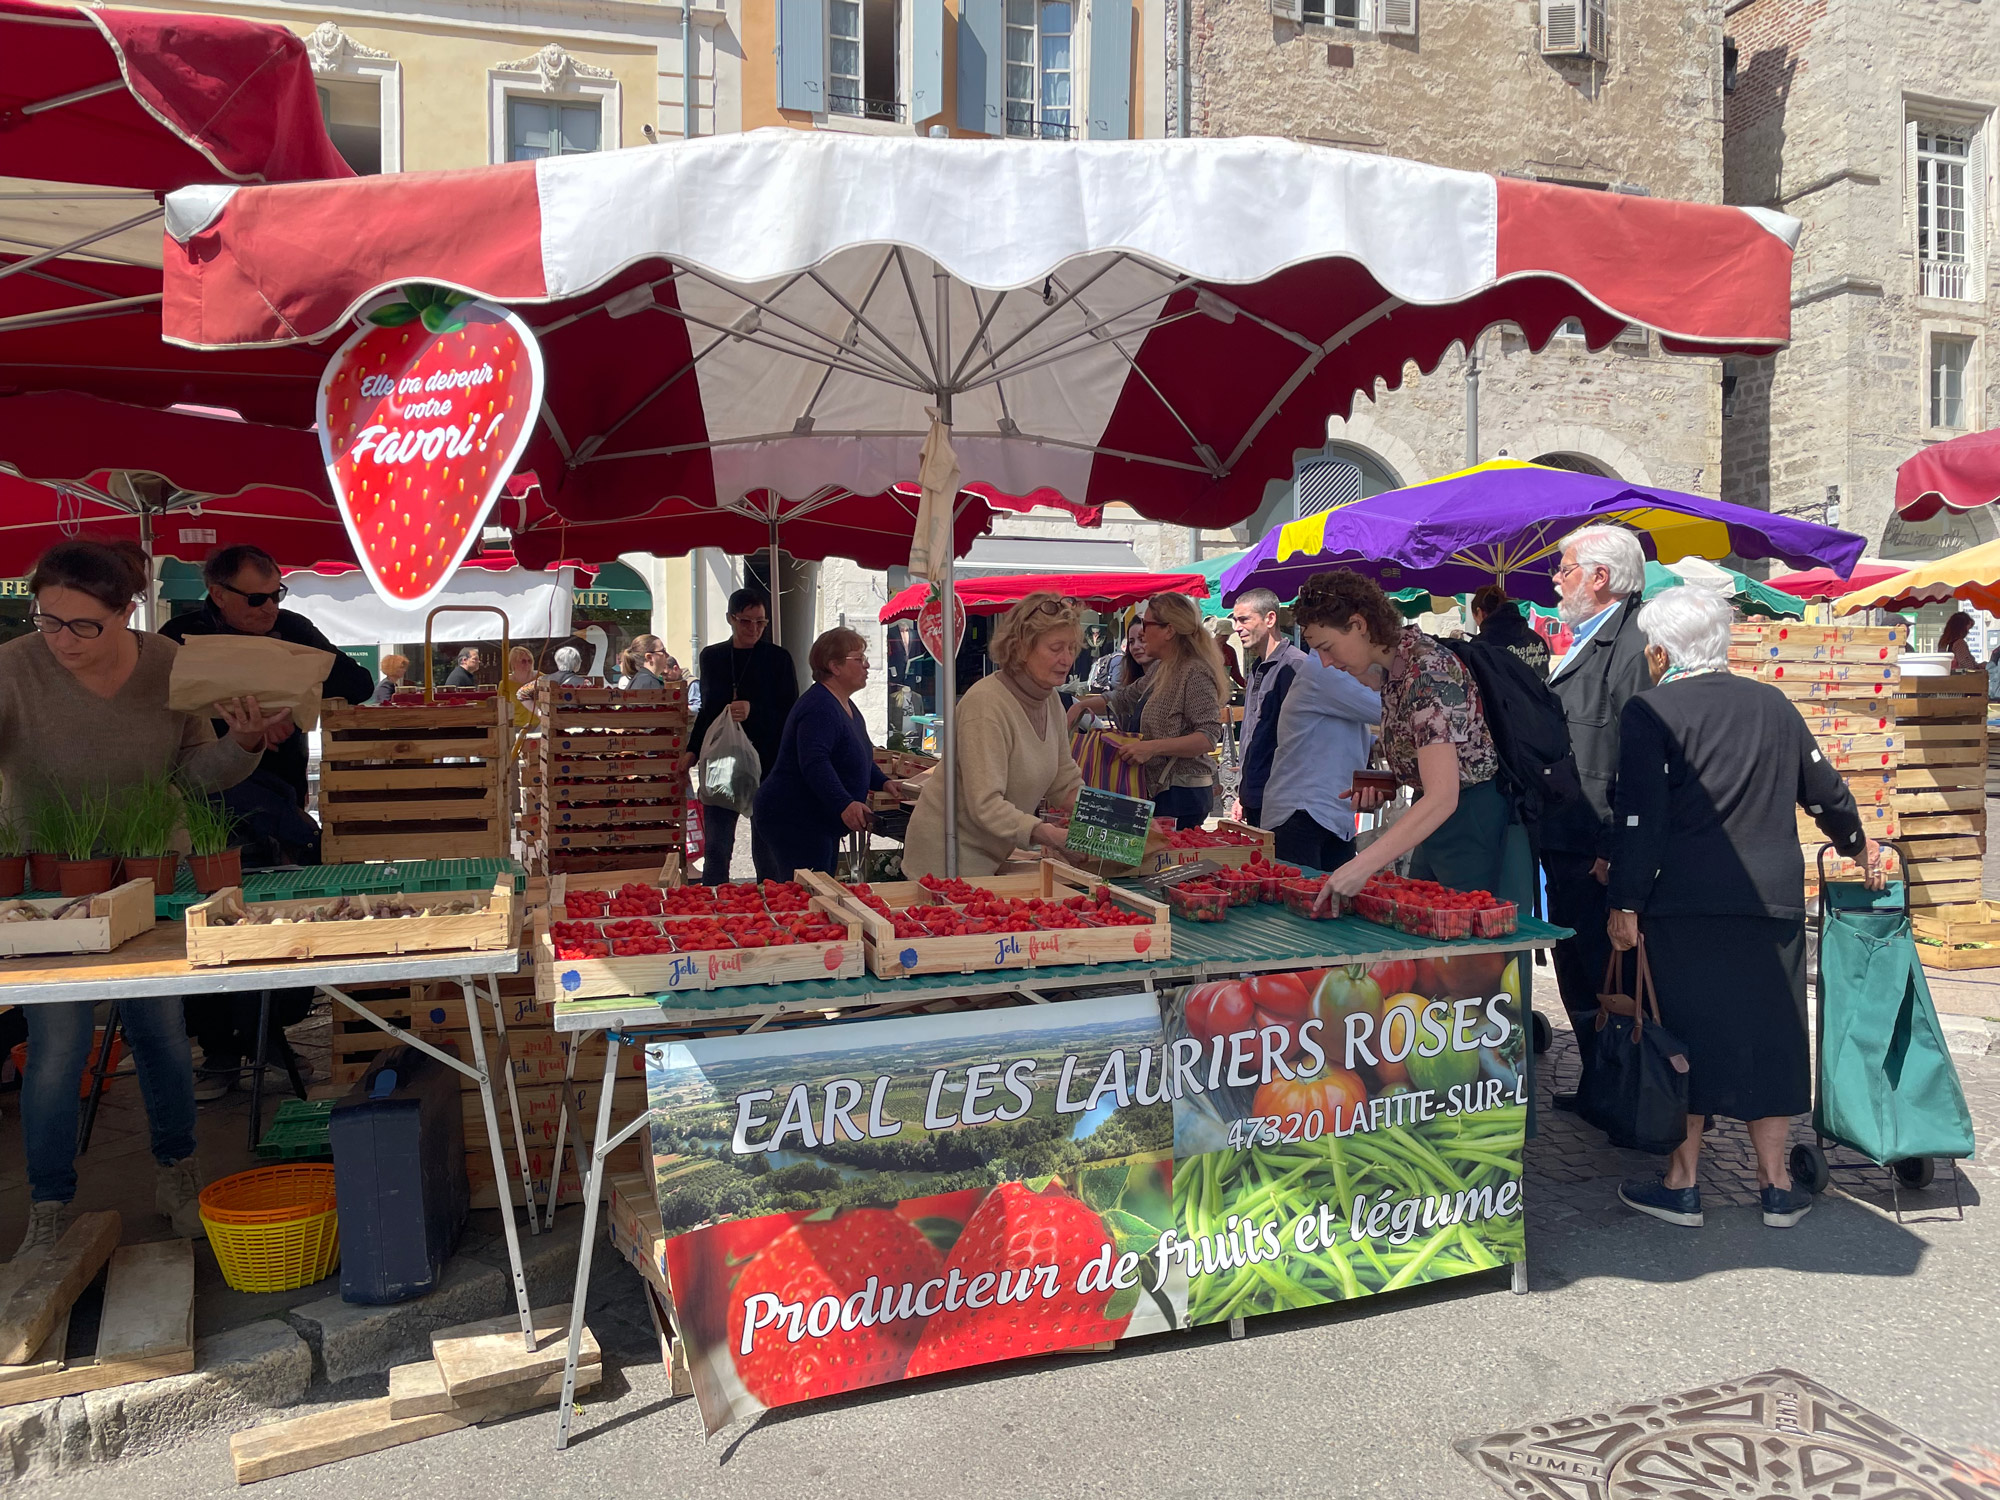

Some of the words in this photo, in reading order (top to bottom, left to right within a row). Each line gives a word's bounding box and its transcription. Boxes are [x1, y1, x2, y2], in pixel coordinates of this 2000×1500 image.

[360, 374, 395, 397] Elle
[398, 377, 422, 394] va
[425, 363, 494, 392] devenir
[404, 398, 453, 420] votre
[1155, 852, 1172, 872] Joli
[994, 936, 1022, 965] Joli
[1029, 934, 1061, 960] fruit
[669, 956, 699, 986] Joli
[708, 953, 744, 981] fruit
[514, 998, 538, 1021] Joli
[731, 1075, 902, 1155] EARL
[924, 1058, 1038, 1131] LES
[1055, 1017, 1326, 1114] LAURIERS
[1343, 992, 1513, 1070] ROSES
[1226, 1109, 1325, 1152] 47320
[1333, 1074, 1528, 1138] LAFITTE-SUR-L
[739, 1262, 1062, 1357] Producteur
[1075, 1242, 1140, 1297] de
[1151, 1213, 1281, 1293] fruits
[1294, 1203, 1337, 1249] et
[1508, 1451, 1606, 1480] FUMEL
